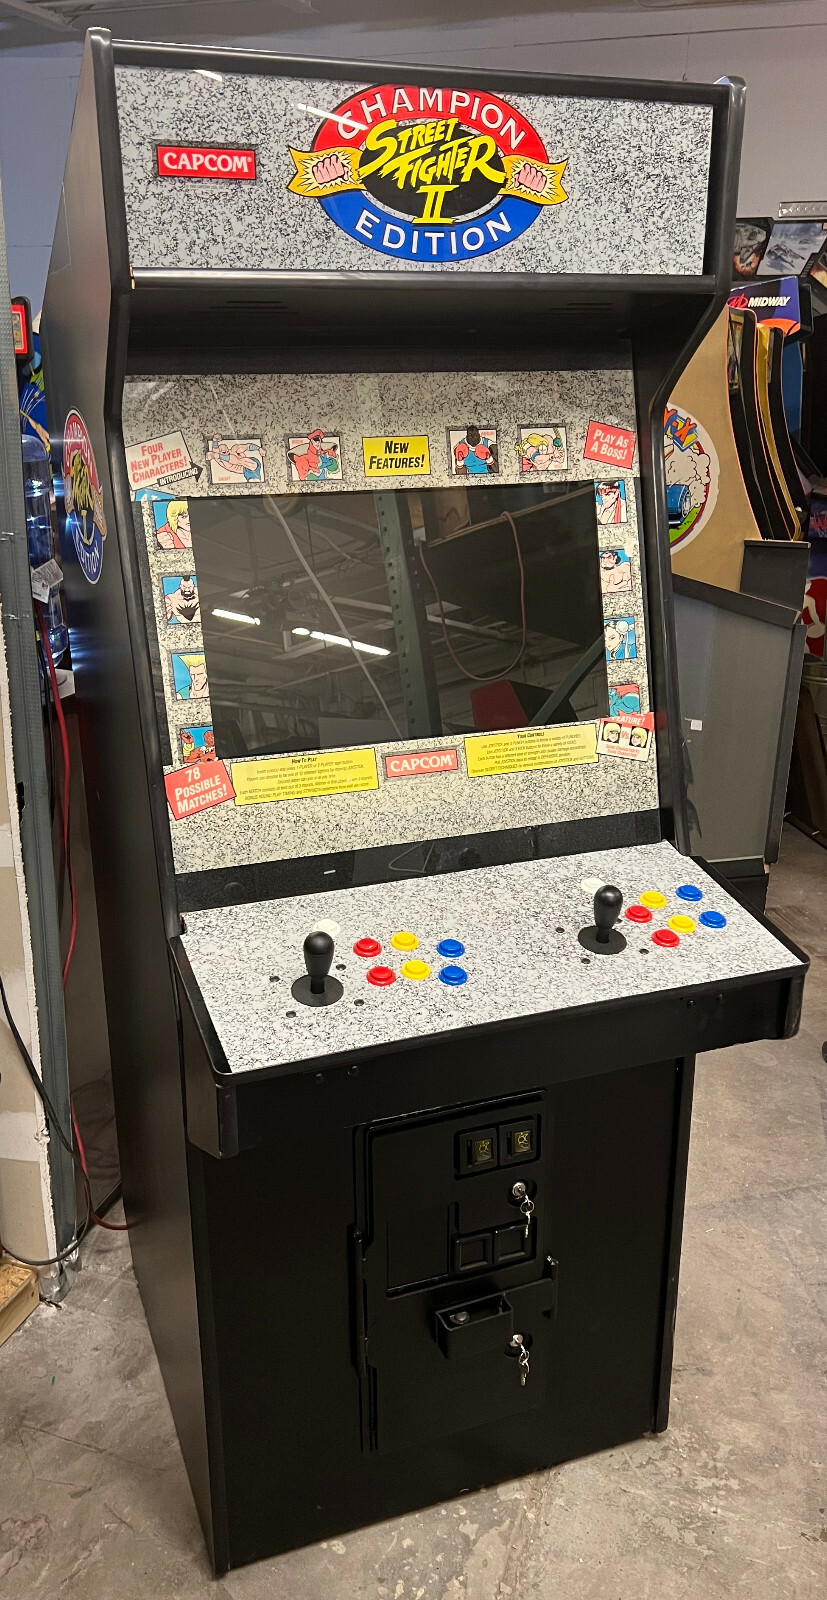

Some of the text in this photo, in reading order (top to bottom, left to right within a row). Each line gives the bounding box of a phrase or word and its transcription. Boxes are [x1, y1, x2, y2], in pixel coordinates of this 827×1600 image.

[337, 87, 526, 150] CHAMPION
[356, 118, 459, 181] STREET
[163, 152, 249, 173] CAPCOM
[377, 135, 507, 189] FIGHTER
[412, 184, 460, 224] II
[355, 209, 512, 255] EDITION
[748, 296, 792, 307] MIDWAY
[384, 440, 409, 454] NEW
[590, 441, 599, 453] A
[593, 429, 616, 444] PLAY
[369, 453, 425, 469] FEATURES!
[390, 754, 452, 772] CAPCOM
[185, 767, 201, 783] 78
[175, 775, 221, 801] POSSIBLE
[177, 784, 227, 814] MATCHES!
